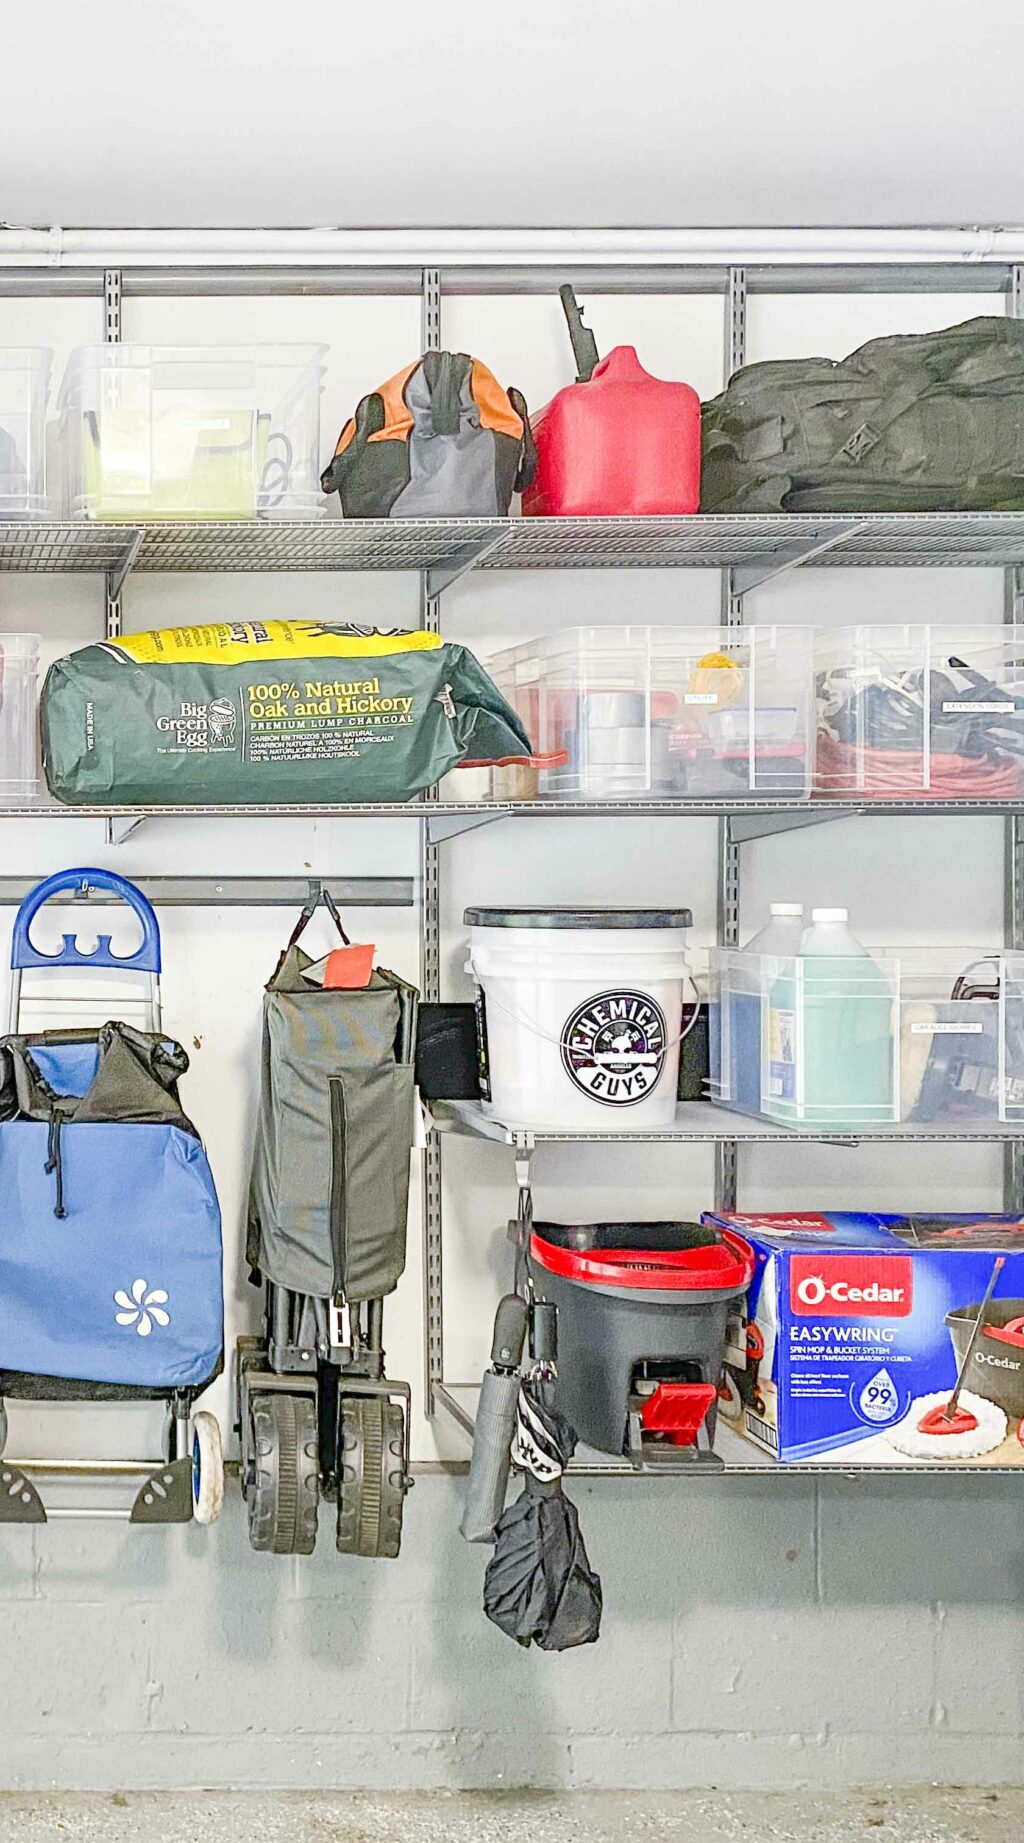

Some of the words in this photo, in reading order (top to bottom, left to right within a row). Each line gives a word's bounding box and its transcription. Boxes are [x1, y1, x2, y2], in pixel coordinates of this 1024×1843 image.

[247, 683, 300, 701] 100%
[305, 677, 381, 698] Natural
[180, 702, 207, 719] Big
[249, 700, 288, 719] Oak
[294, 698, 331, 717] and
[337, 695, 414, 714] Hickory
[156, 716, 208, 731] Green
[250, 719, 306, 731] PREMIUM
[311, 718, 343, 729] LUMP
[348, 715, 414, 725] CHARCOAL
[176, 730, 208, 747] Egg
[571, 999, 662, 1051] CHEMICAL
[590, 1071, 647, 1096] GUYS
[797, 1277, 905, 1305] O-Cedar
[789, 1346, 806, 1354] SPIN
[807, 1346, 824, 1354] MOP
[825, 1346, 833, 1354] &
[834, 1346, 861, 1354] BUCKET
[975, 1351, 1021, 1370] O-Cedar
